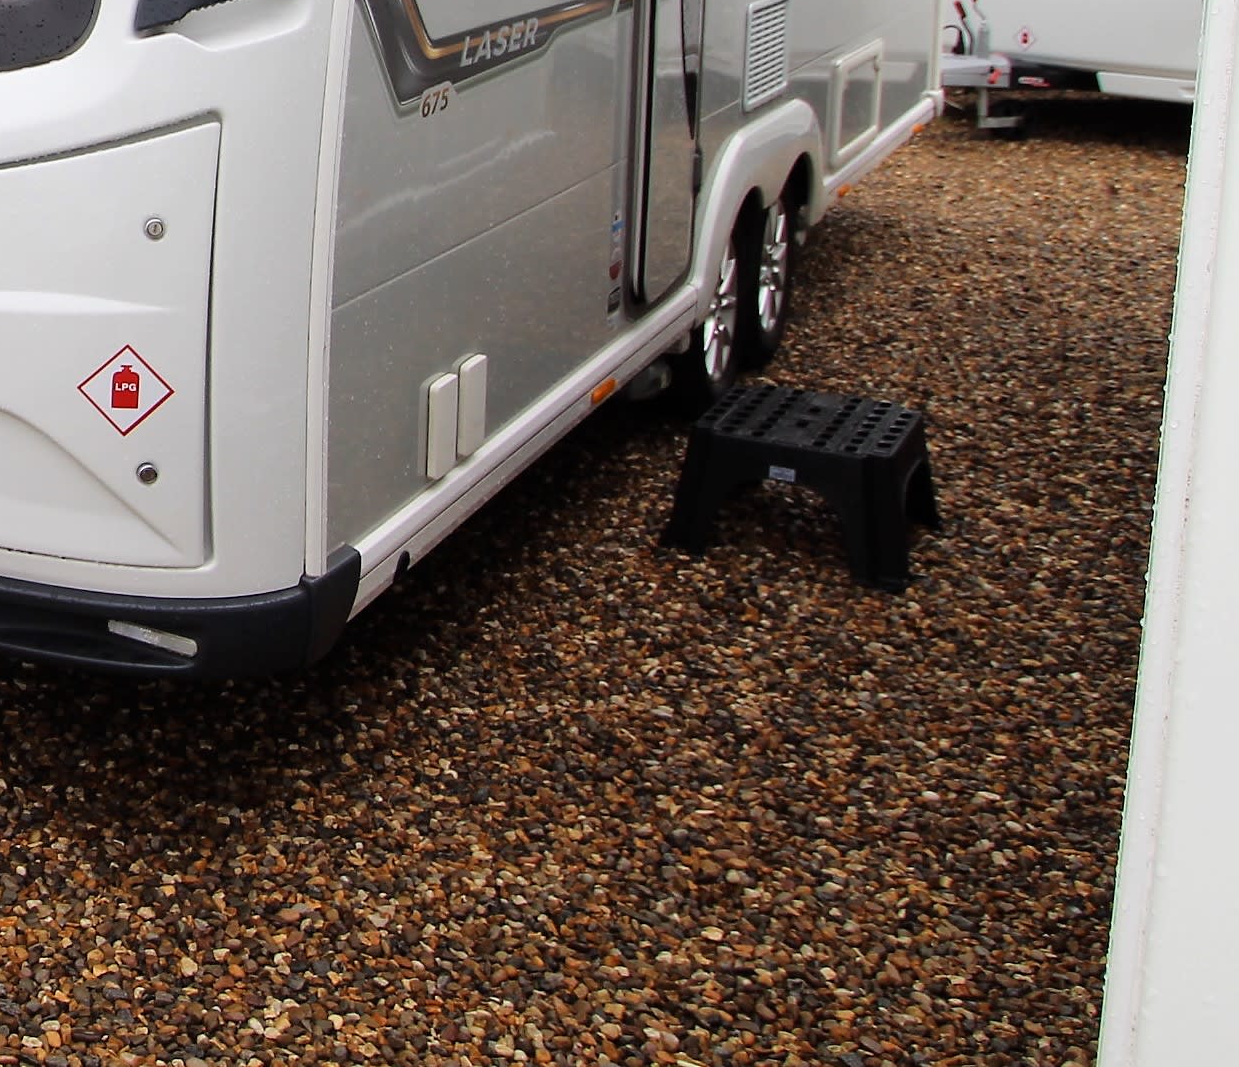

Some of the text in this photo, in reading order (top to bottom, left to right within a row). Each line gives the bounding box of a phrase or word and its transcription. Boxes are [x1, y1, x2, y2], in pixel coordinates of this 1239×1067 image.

[460, 18, 539, 67] LASER
[422, 88, 450, 118] 675
[115, 382, 137, 392] LPG
